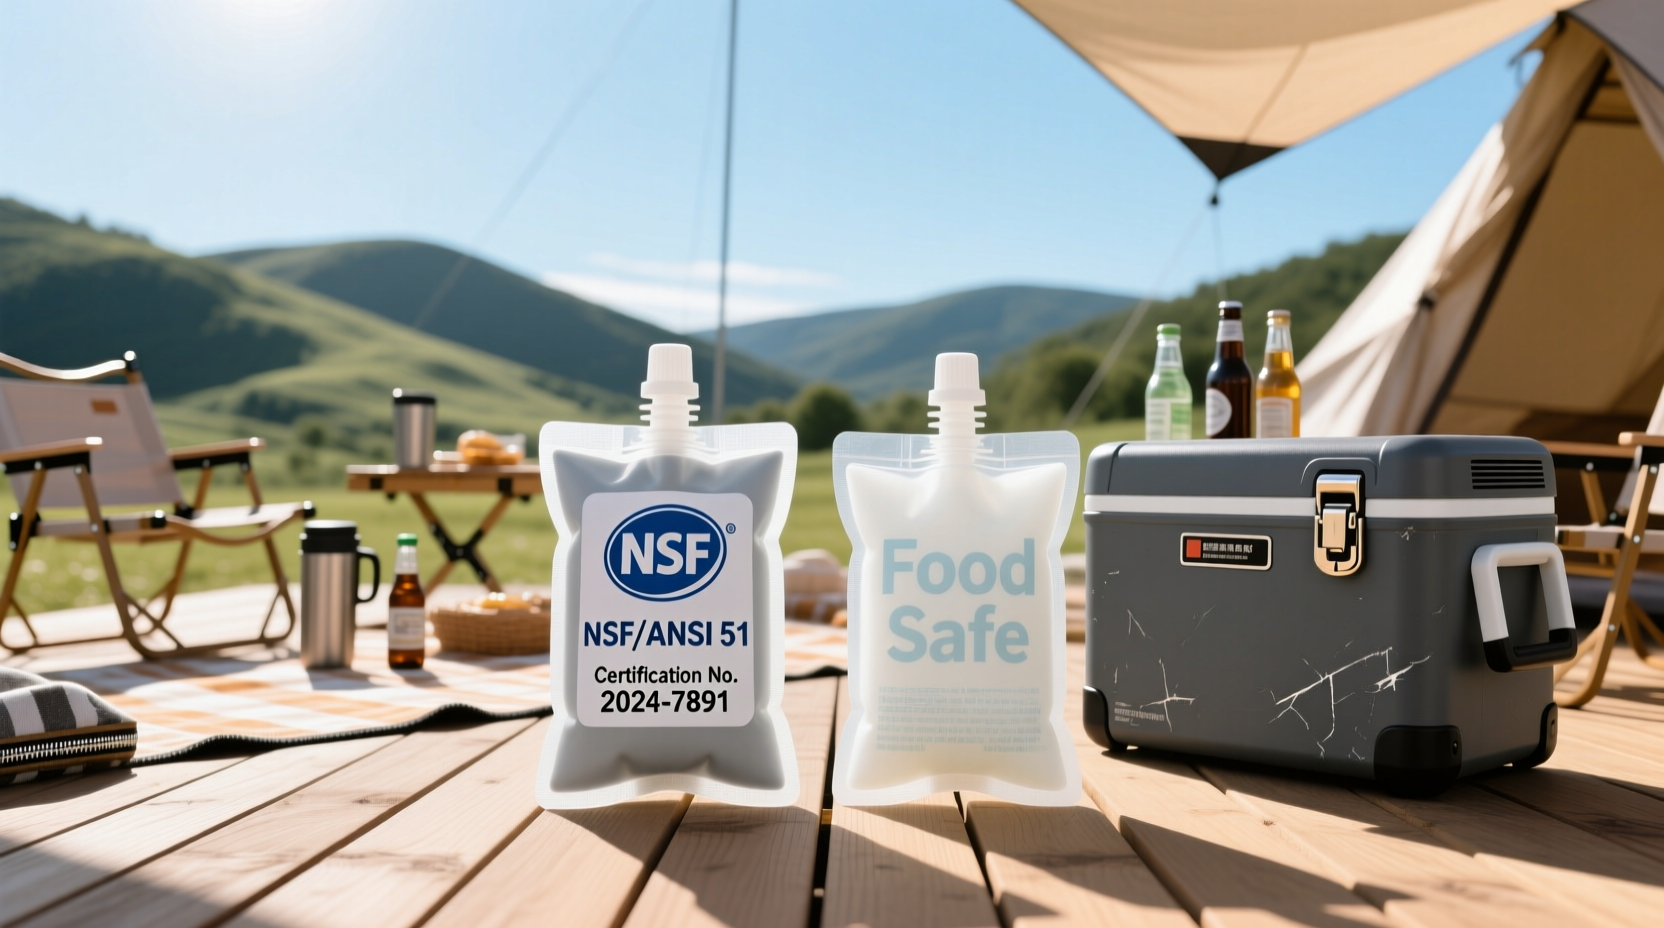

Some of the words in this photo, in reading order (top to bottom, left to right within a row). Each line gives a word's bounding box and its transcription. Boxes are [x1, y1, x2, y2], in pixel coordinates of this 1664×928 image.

[620, 532, 711, 575] NSF
[882, 538, 1035, 596] Food
[584, 619, 712, 651] NSF/ANSI
[720, 621, 748, 647] 51
[887, 604, 1029, 664] Safe
[594, 665, 702, 684] Certification
[708, 665, 738, 684] No.
[600, 690, 728, 713] 2024-7891
